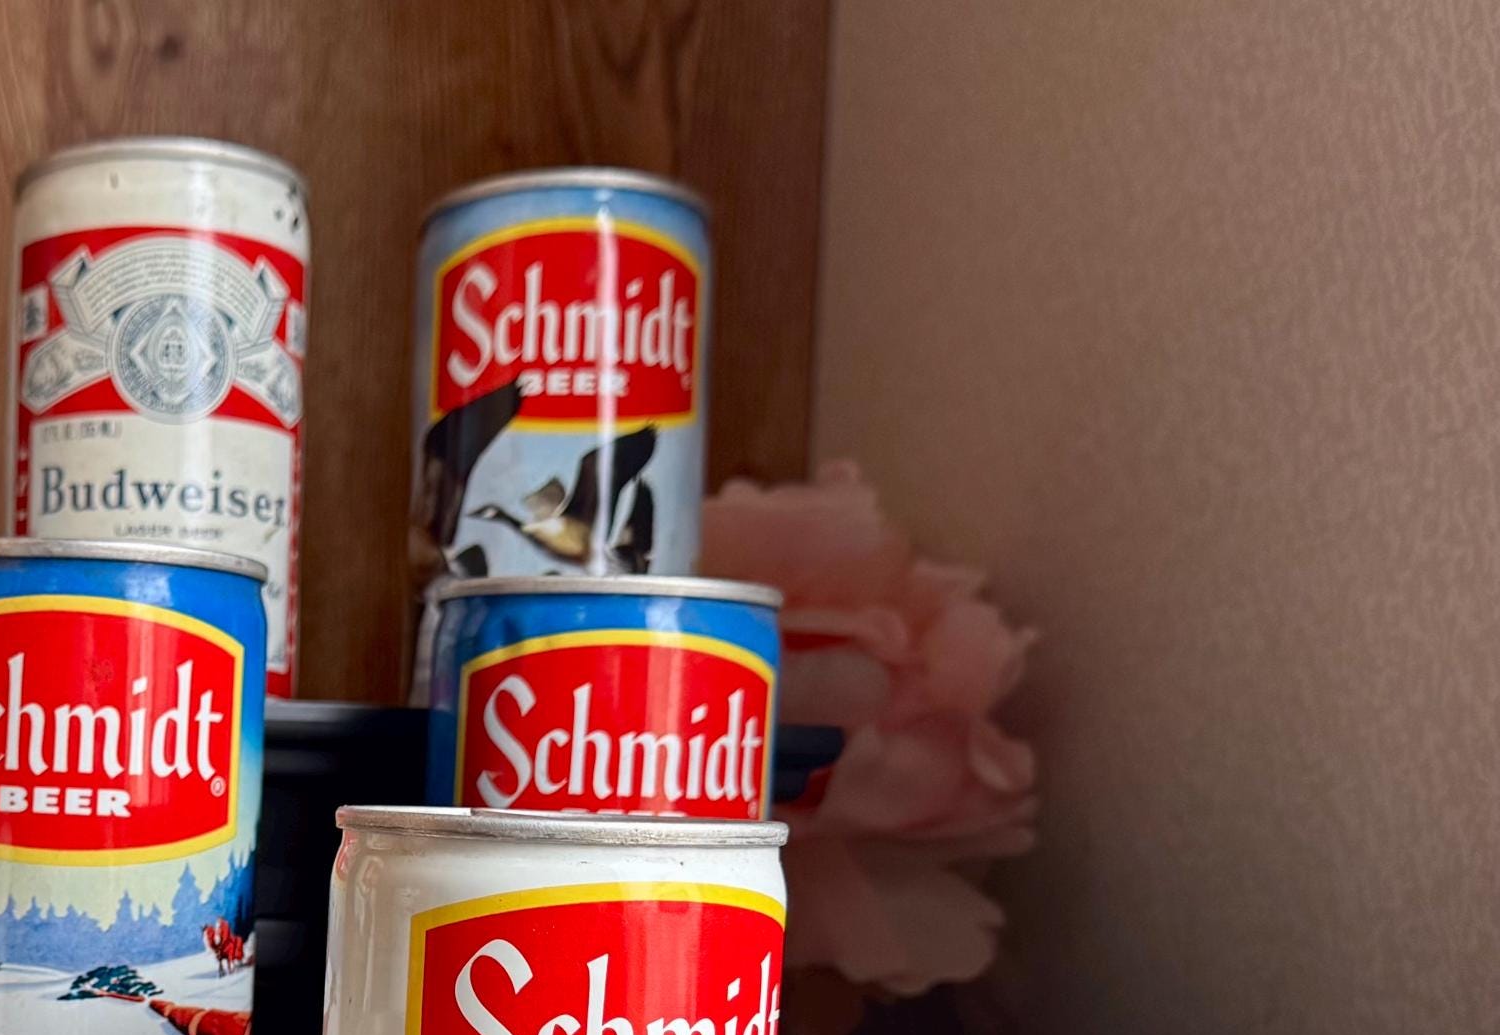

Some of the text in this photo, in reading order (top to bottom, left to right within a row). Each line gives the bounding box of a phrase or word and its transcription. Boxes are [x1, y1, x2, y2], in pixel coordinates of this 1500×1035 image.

[447, 261, 694, 388] Schmidt
[517, 368, 629, 399] BEER
[40, 466, 287, 527] Budweiser
[476, 673, 762, 808] Schmidt
